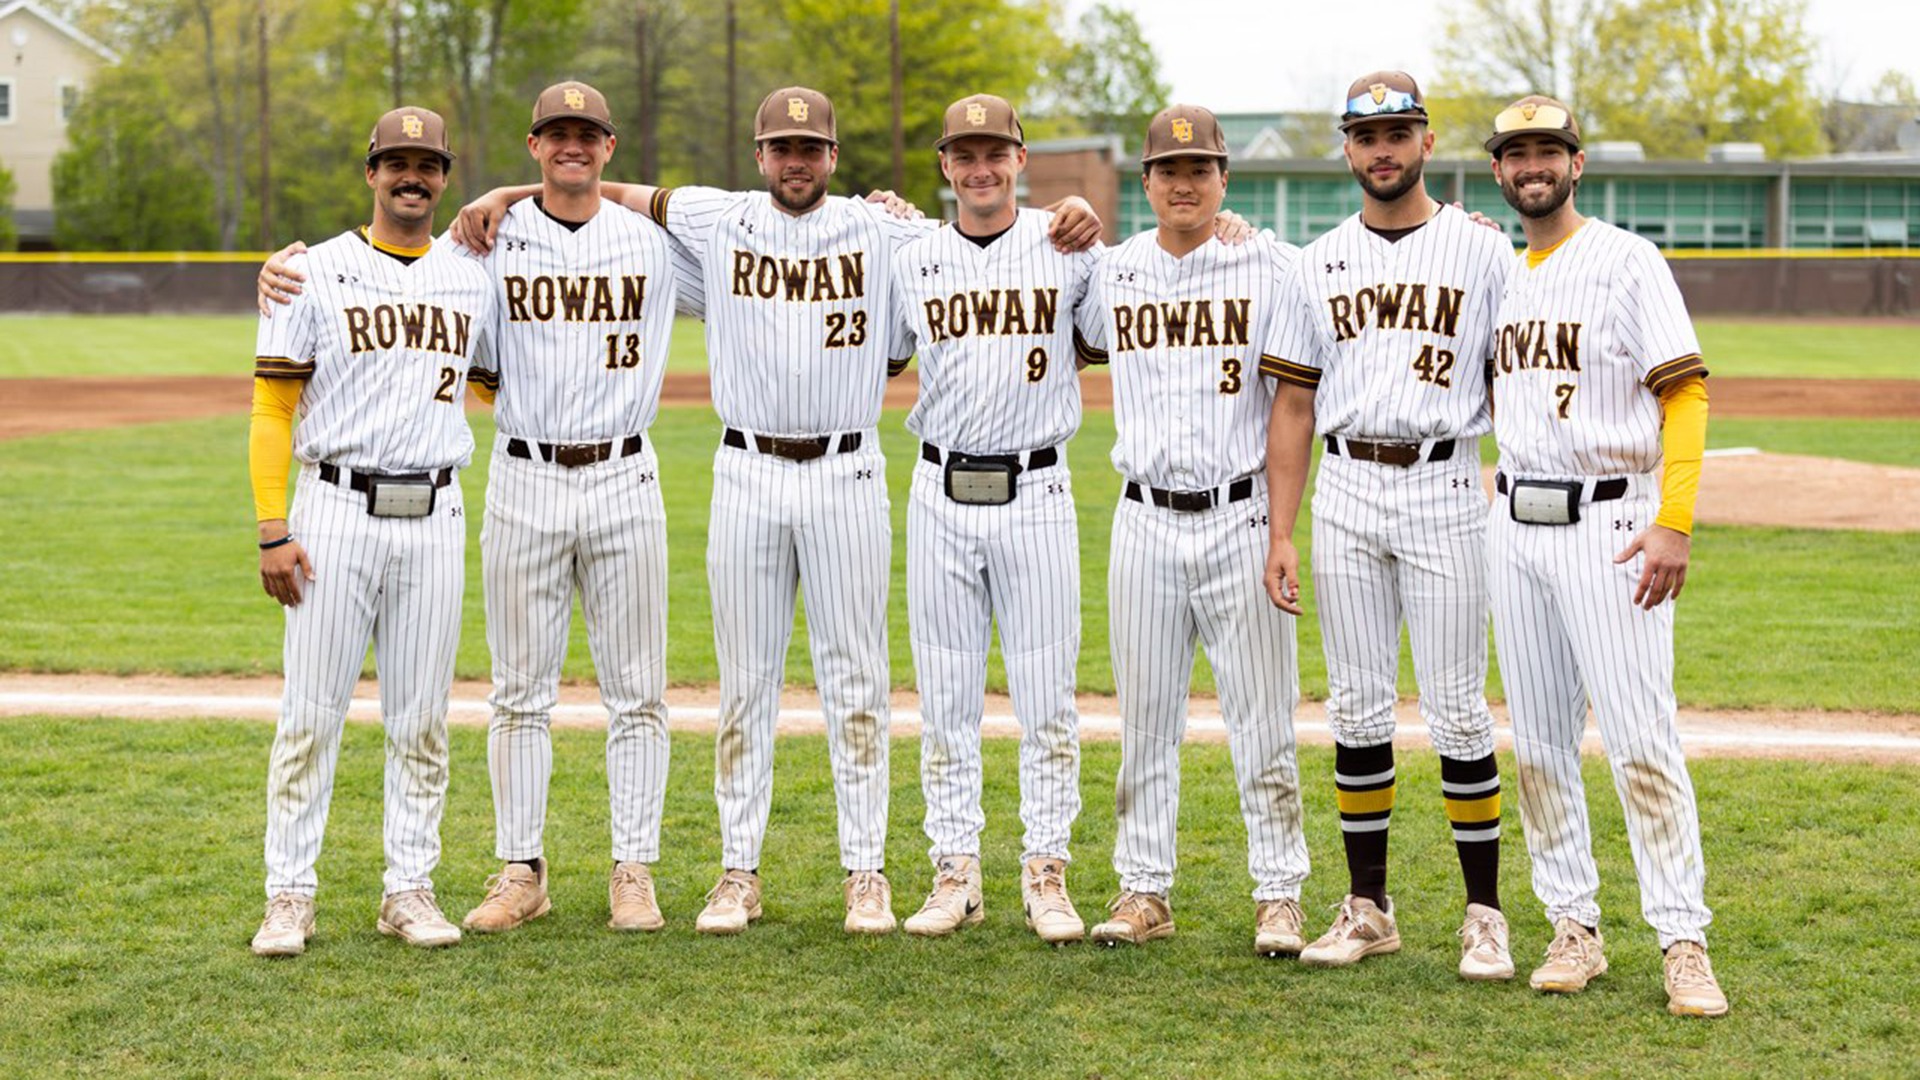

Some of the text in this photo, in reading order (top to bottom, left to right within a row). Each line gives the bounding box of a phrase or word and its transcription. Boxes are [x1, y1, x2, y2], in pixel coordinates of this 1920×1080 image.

[732, 249, 866, 302] ROWAN
[504, 275, 647, 323] ROWAN
[924, 288, 1059, 343] ROWAN
[1327, 283, 1466, 343] ROWAN
[344, 304, 472, 358] ROWAN
[825, 310, 868, 348] 23
[1113, 298, 1252, 352] ROWAN
[605, 333, 640, 370] 13
[1026, 347, 1049, 384] 9
[1413, 344, 1456, 389] 42
[433, 366, 464, 404] 2
[1219, 358, 1243, 395] 3
[1554, 382, 1577, 420] 7
